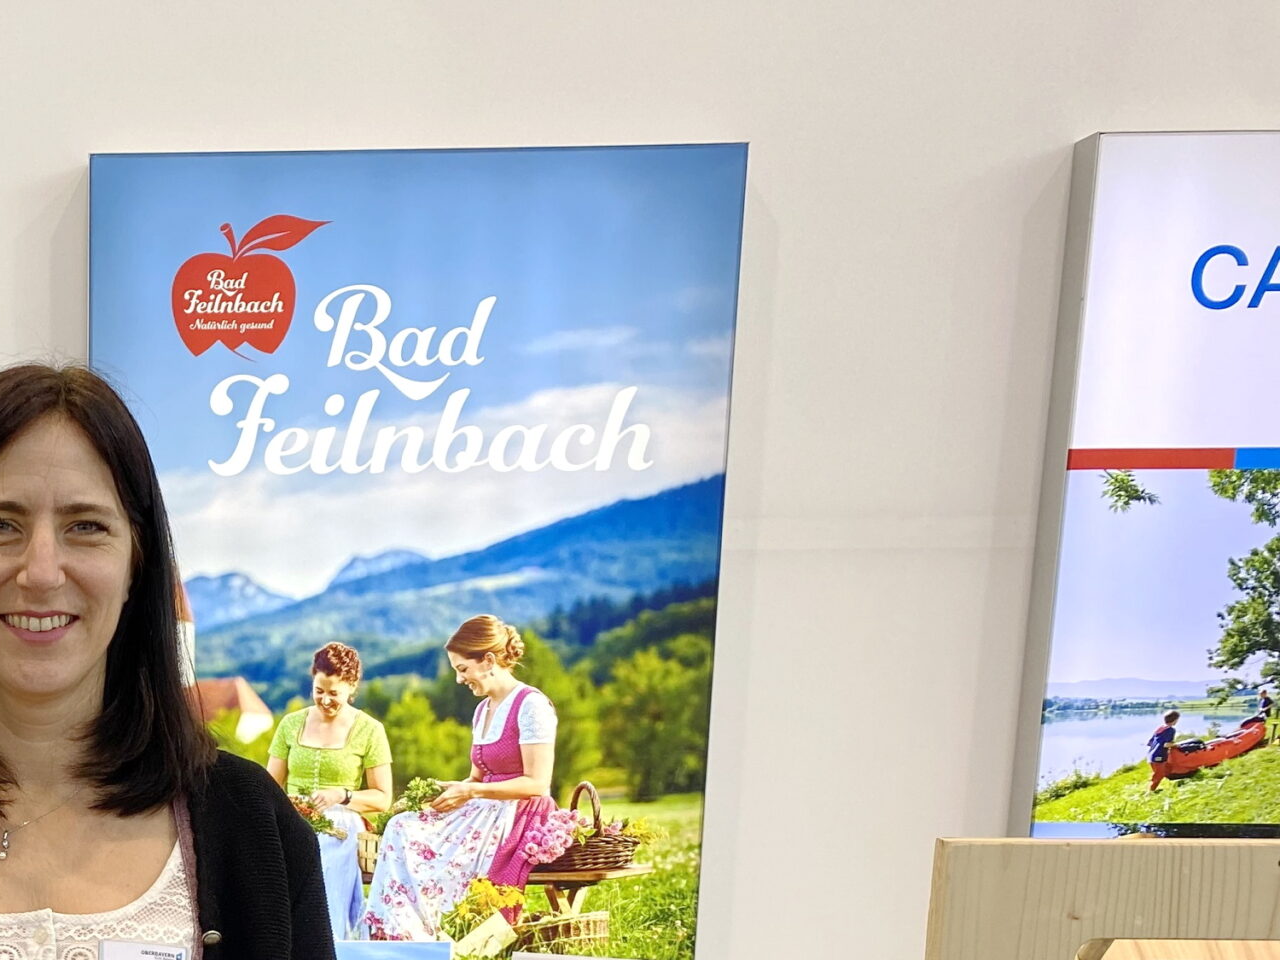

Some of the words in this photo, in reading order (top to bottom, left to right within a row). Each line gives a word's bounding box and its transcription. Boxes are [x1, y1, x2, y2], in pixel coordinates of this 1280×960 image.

[207, 269, 248, 297] Bad
[183, 289, 284, 314] Feilnbach
[188, 318, 238, 331] Natürlich
[239, 319, 276, 334] gesund
[313, 284, 498, 400] Bad
[208, 372, 655, 477] Feilnbach
